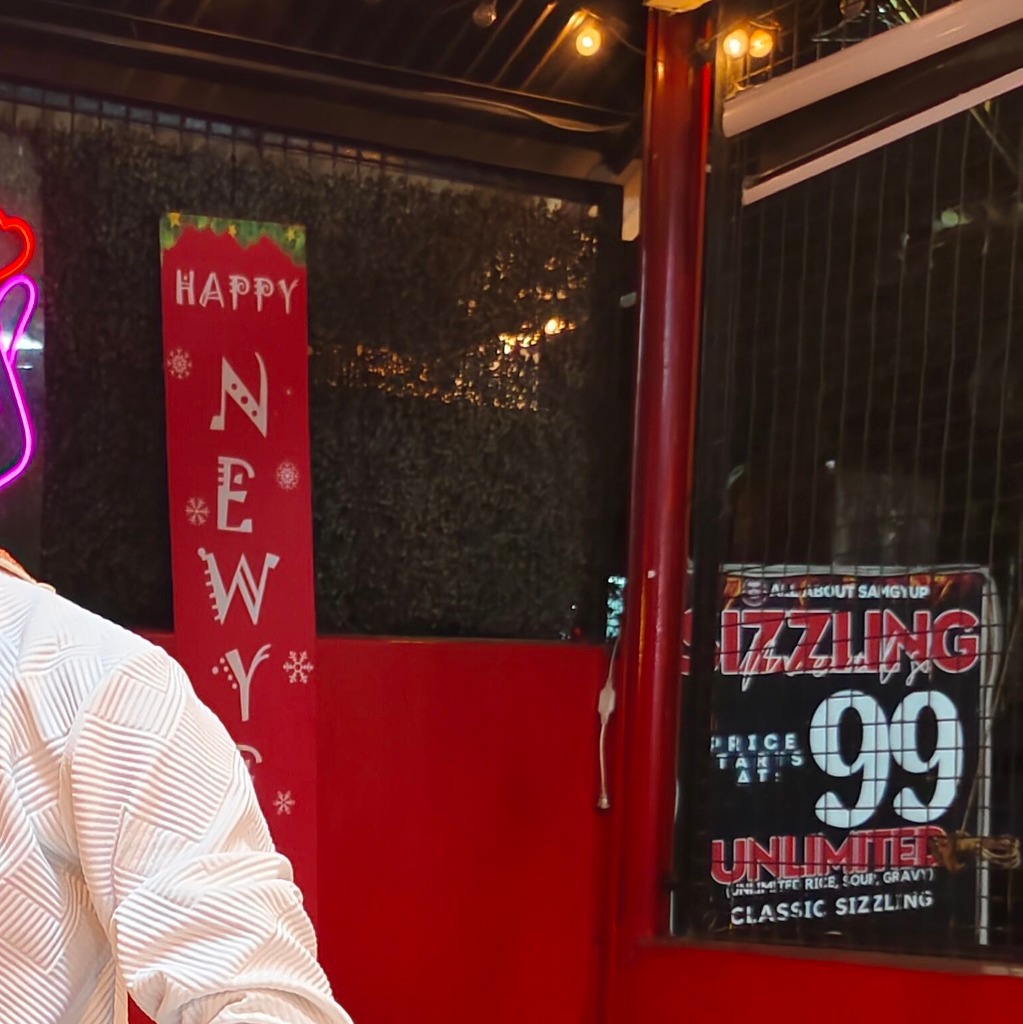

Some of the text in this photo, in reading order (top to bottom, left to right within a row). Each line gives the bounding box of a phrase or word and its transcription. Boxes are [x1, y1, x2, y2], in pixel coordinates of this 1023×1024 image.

[175, 269, 299, 315] HAPPY
[803, 584, 856, 598] ABOUT
[857, 584, 931, 599] SAMGYUP
[709, 733, 797, 752] PRICE
[715, 750, 805, 770] TARTS
[809, 688, 965, 829] 99
[730, 890, 934, 926] CLASSIC SIZZLING
